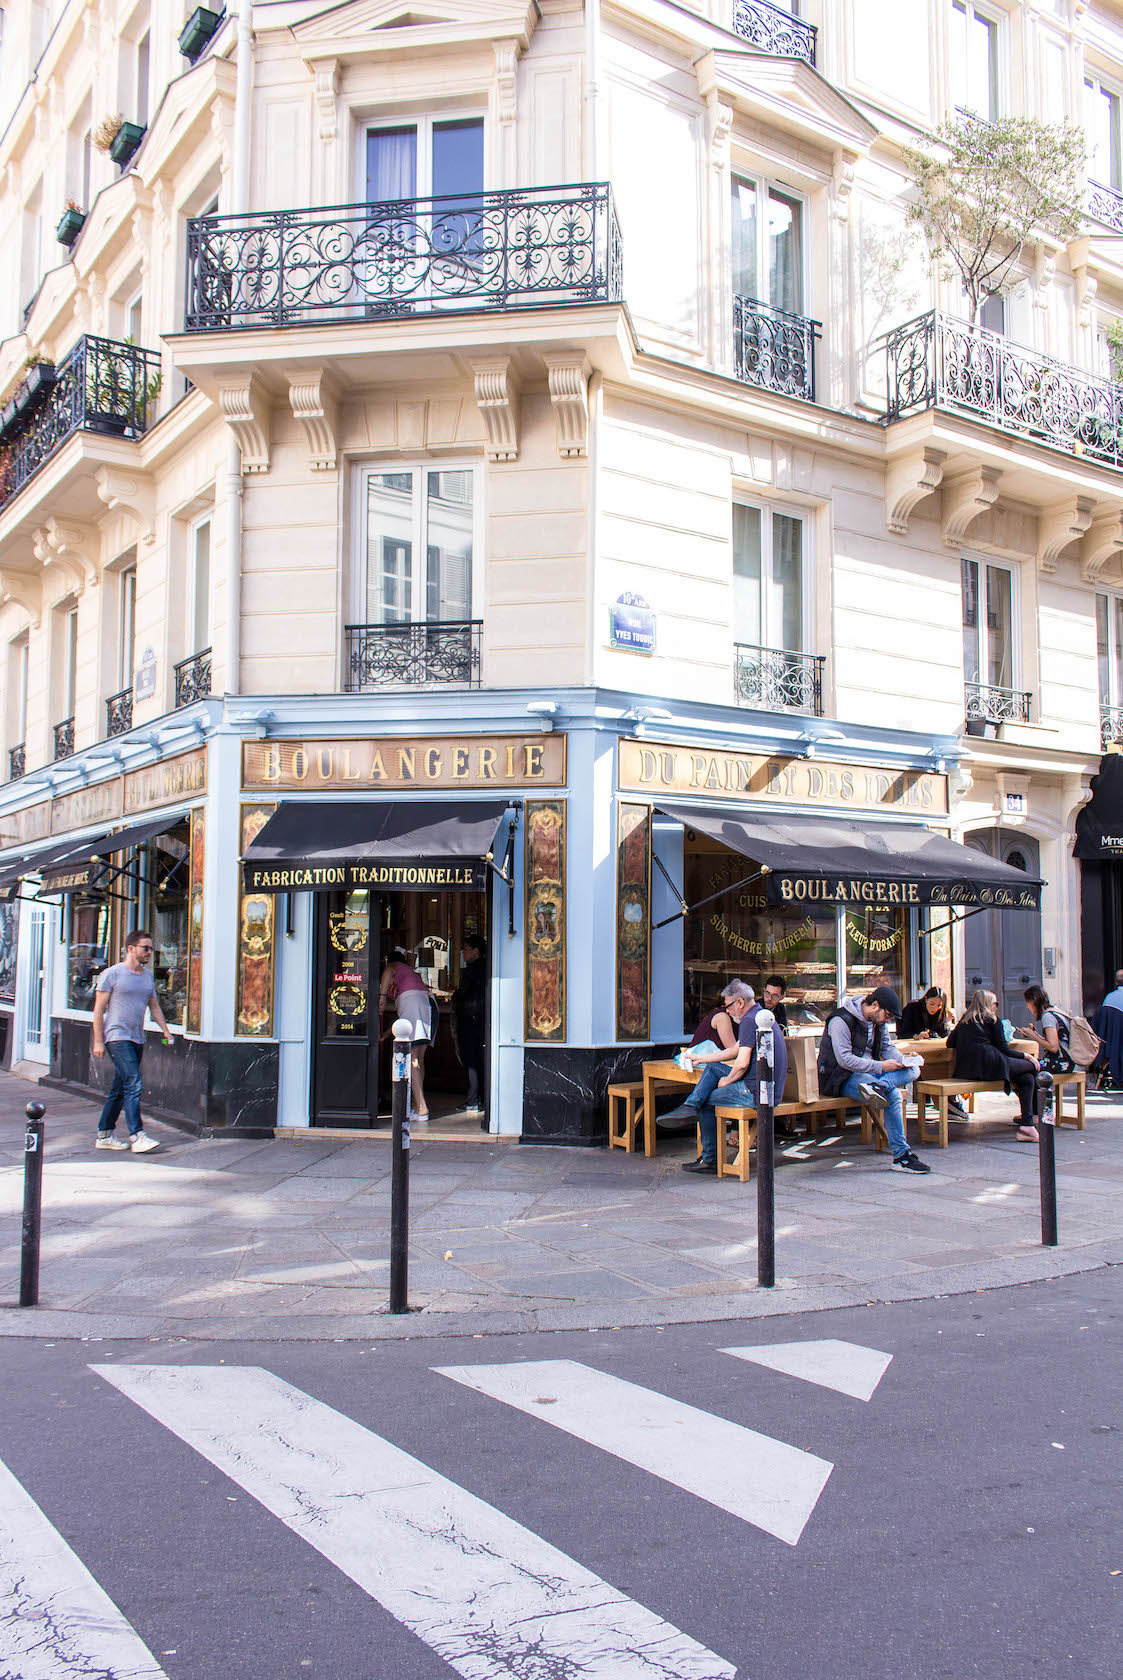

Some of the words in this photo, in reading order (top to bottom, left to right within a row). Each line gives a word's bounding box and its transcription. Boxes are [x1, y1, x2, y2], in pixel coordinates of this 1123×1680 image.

[615, 629, 632, 641] YVES
[261, 744, 546, 782] BOULANGERIE
[640, 749, 678, 785] DU
[689, 754, 753, 792] PAIN
[767, 762, 796, 796] ET
[807, 767, 854, 801] DES
[1008, 795, 1021, 811] 34
[253, 867, 346, 886] FABRICATION
[350, 867, 473, 885] TRADITIONNELLE
[781, 878, 921, 904] BOULANGERIE
[929, 884, 948, 903] Du
[950, 884, 977, 903] Pain
[980, 888, 994, 904] &
[995, 888, 1013, 906] Des
[710, 914, 729, 938] SUR
[728, 931, 763, 954] PIERRE
[765, 915, 815, 954] NATURELLE
[846, 921, 869, 949] FLEUR
[343, 974, 363, 982] Point
